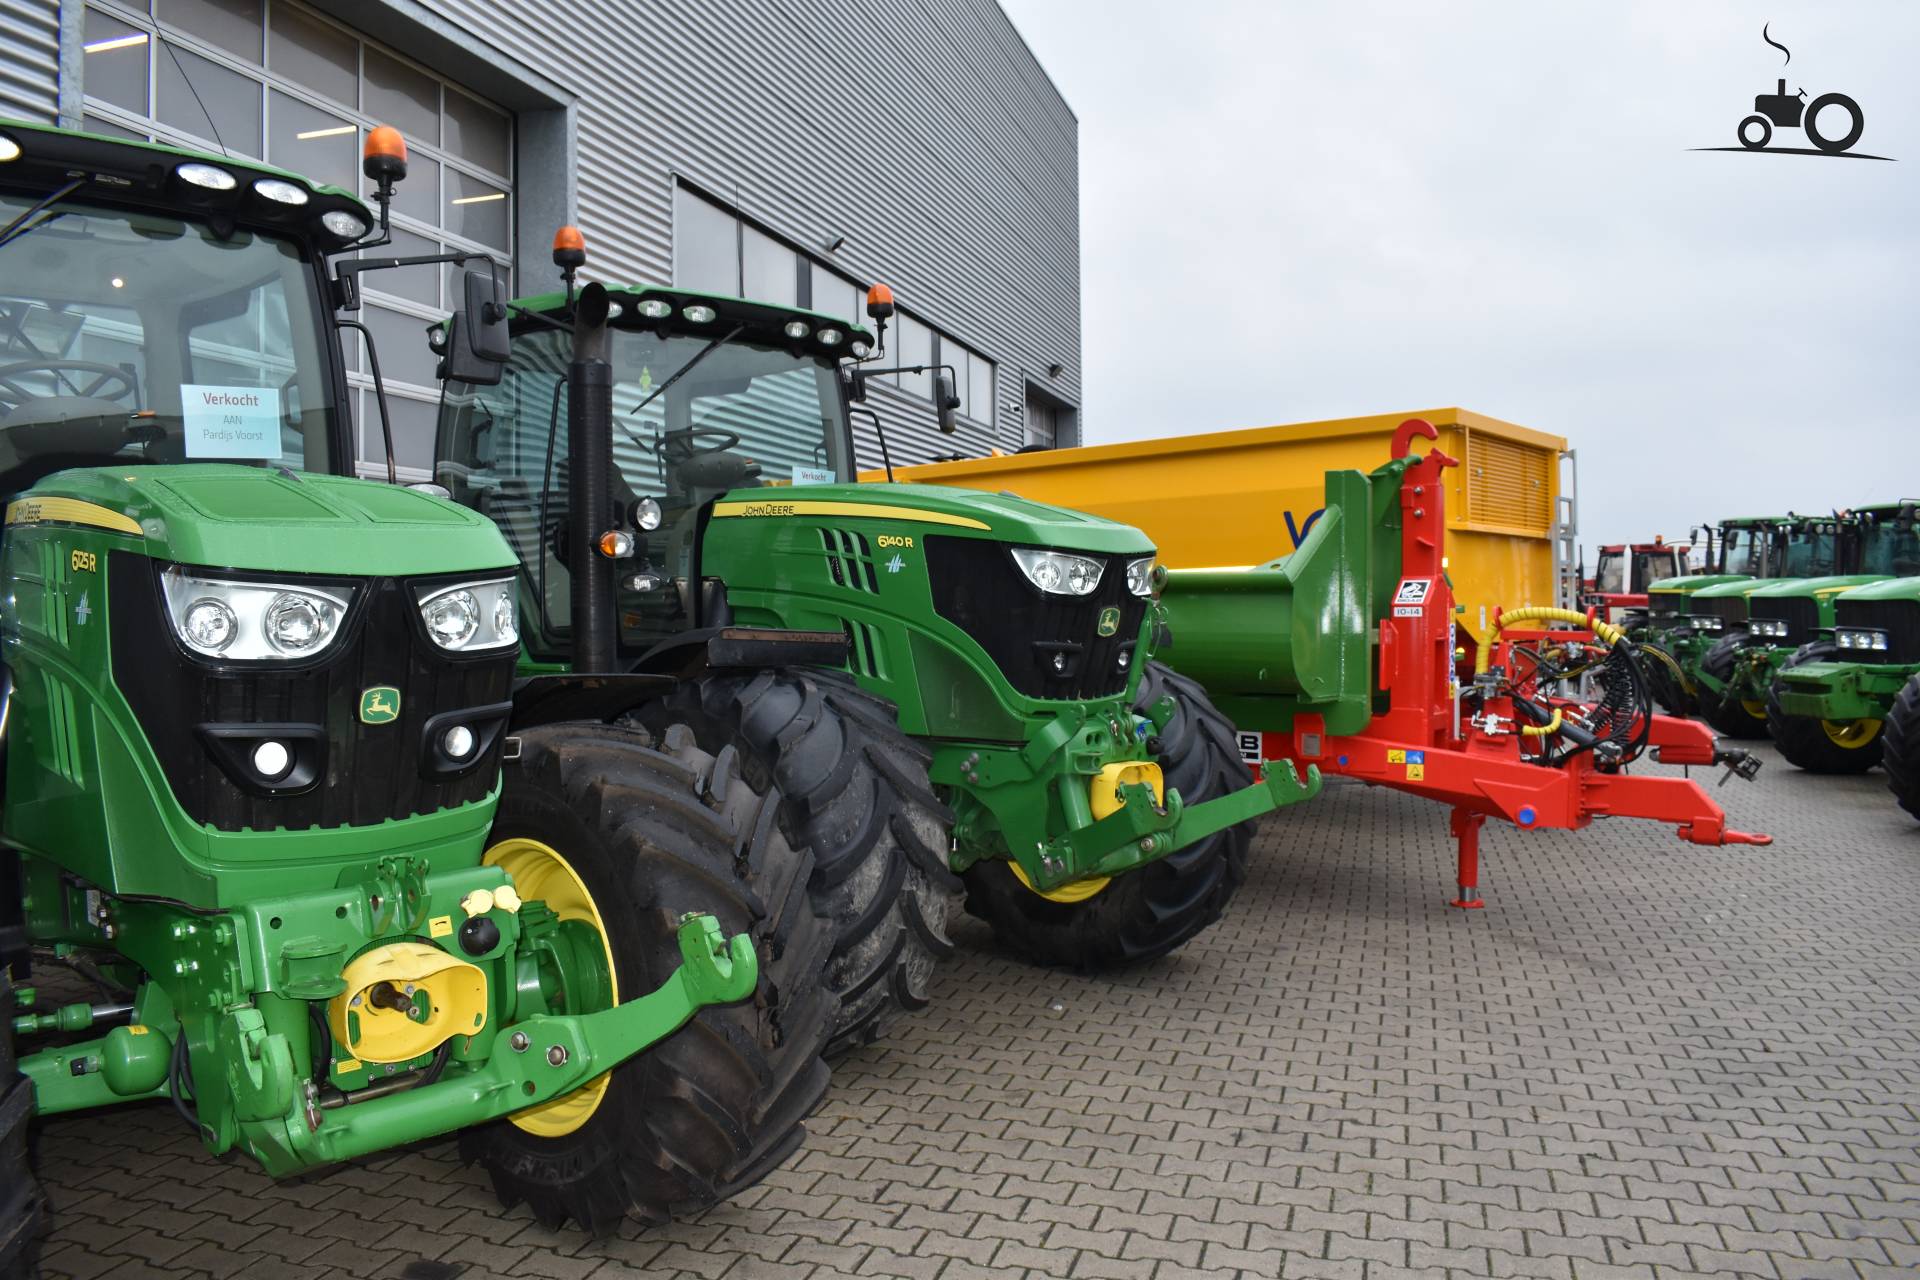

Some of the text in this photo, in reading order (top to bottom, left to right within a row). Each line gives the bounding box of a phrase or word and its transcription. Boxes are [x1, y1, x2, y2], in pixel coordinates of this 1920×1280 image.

[203, 393, 258, 406] Verkocht
[223, 415, 242, 425] AAN
[203, 429, 263, 442] Pardijs Voorst
[801, 471, 827, 482] Verkocht
[742, 504, 794, 515] JOHN DEERE
